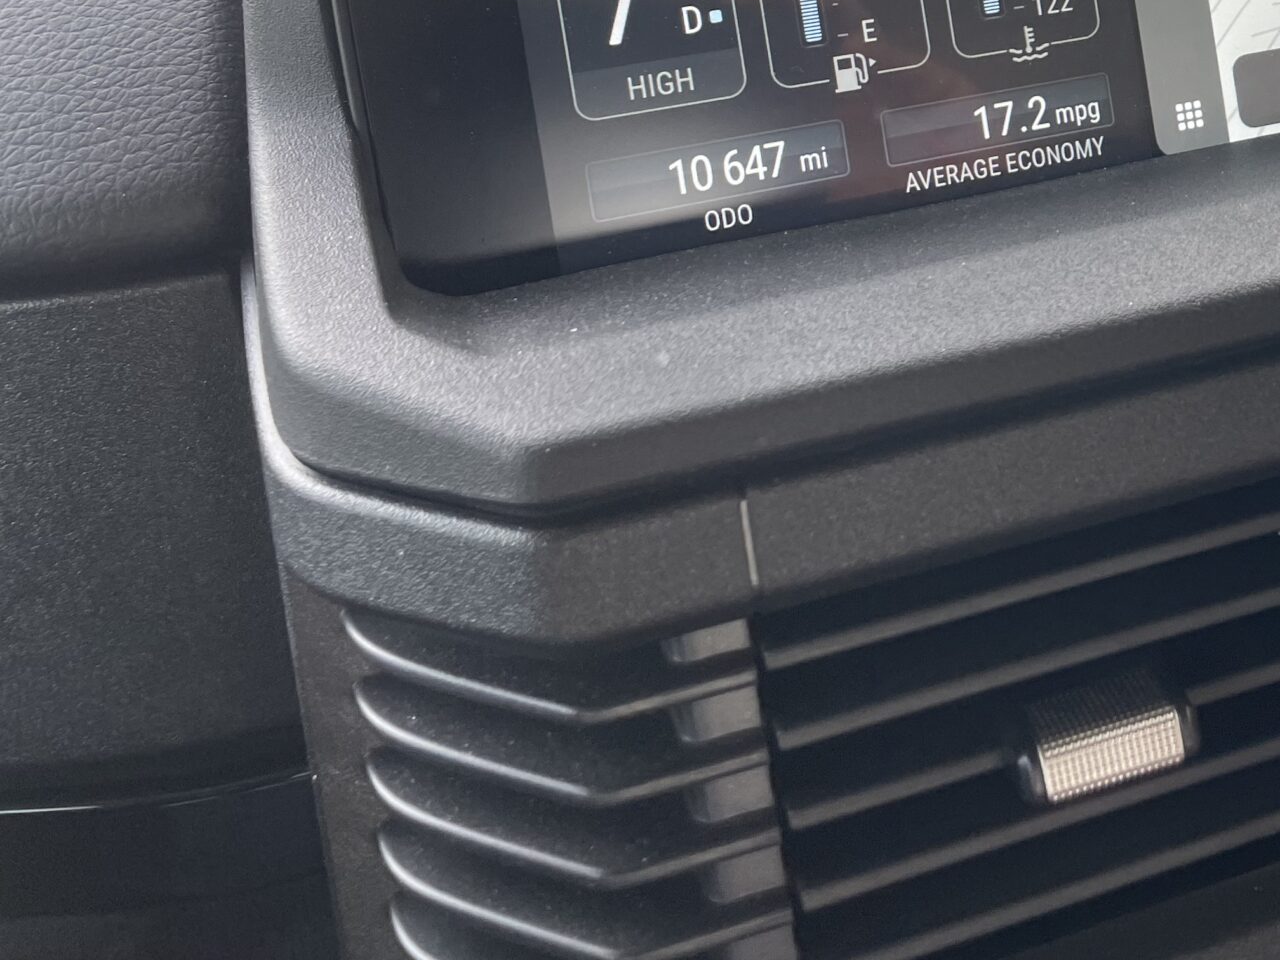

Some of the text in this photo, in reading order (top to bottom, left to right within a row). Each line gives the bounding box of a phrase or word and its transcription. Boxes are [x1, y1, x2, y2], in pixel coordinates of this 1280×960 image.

[681, 6, 703, 35] D
[861, 19, 877, 42] E
[626, 68, 696, 102] HIGH
[972, 95, 1101, 141] 17.2 mpg
[799, 147, 829, 173] mi
[905, 136, 1105, 193] AVERAGE ECONOMY
[704, 204, 753, 232] ODO
